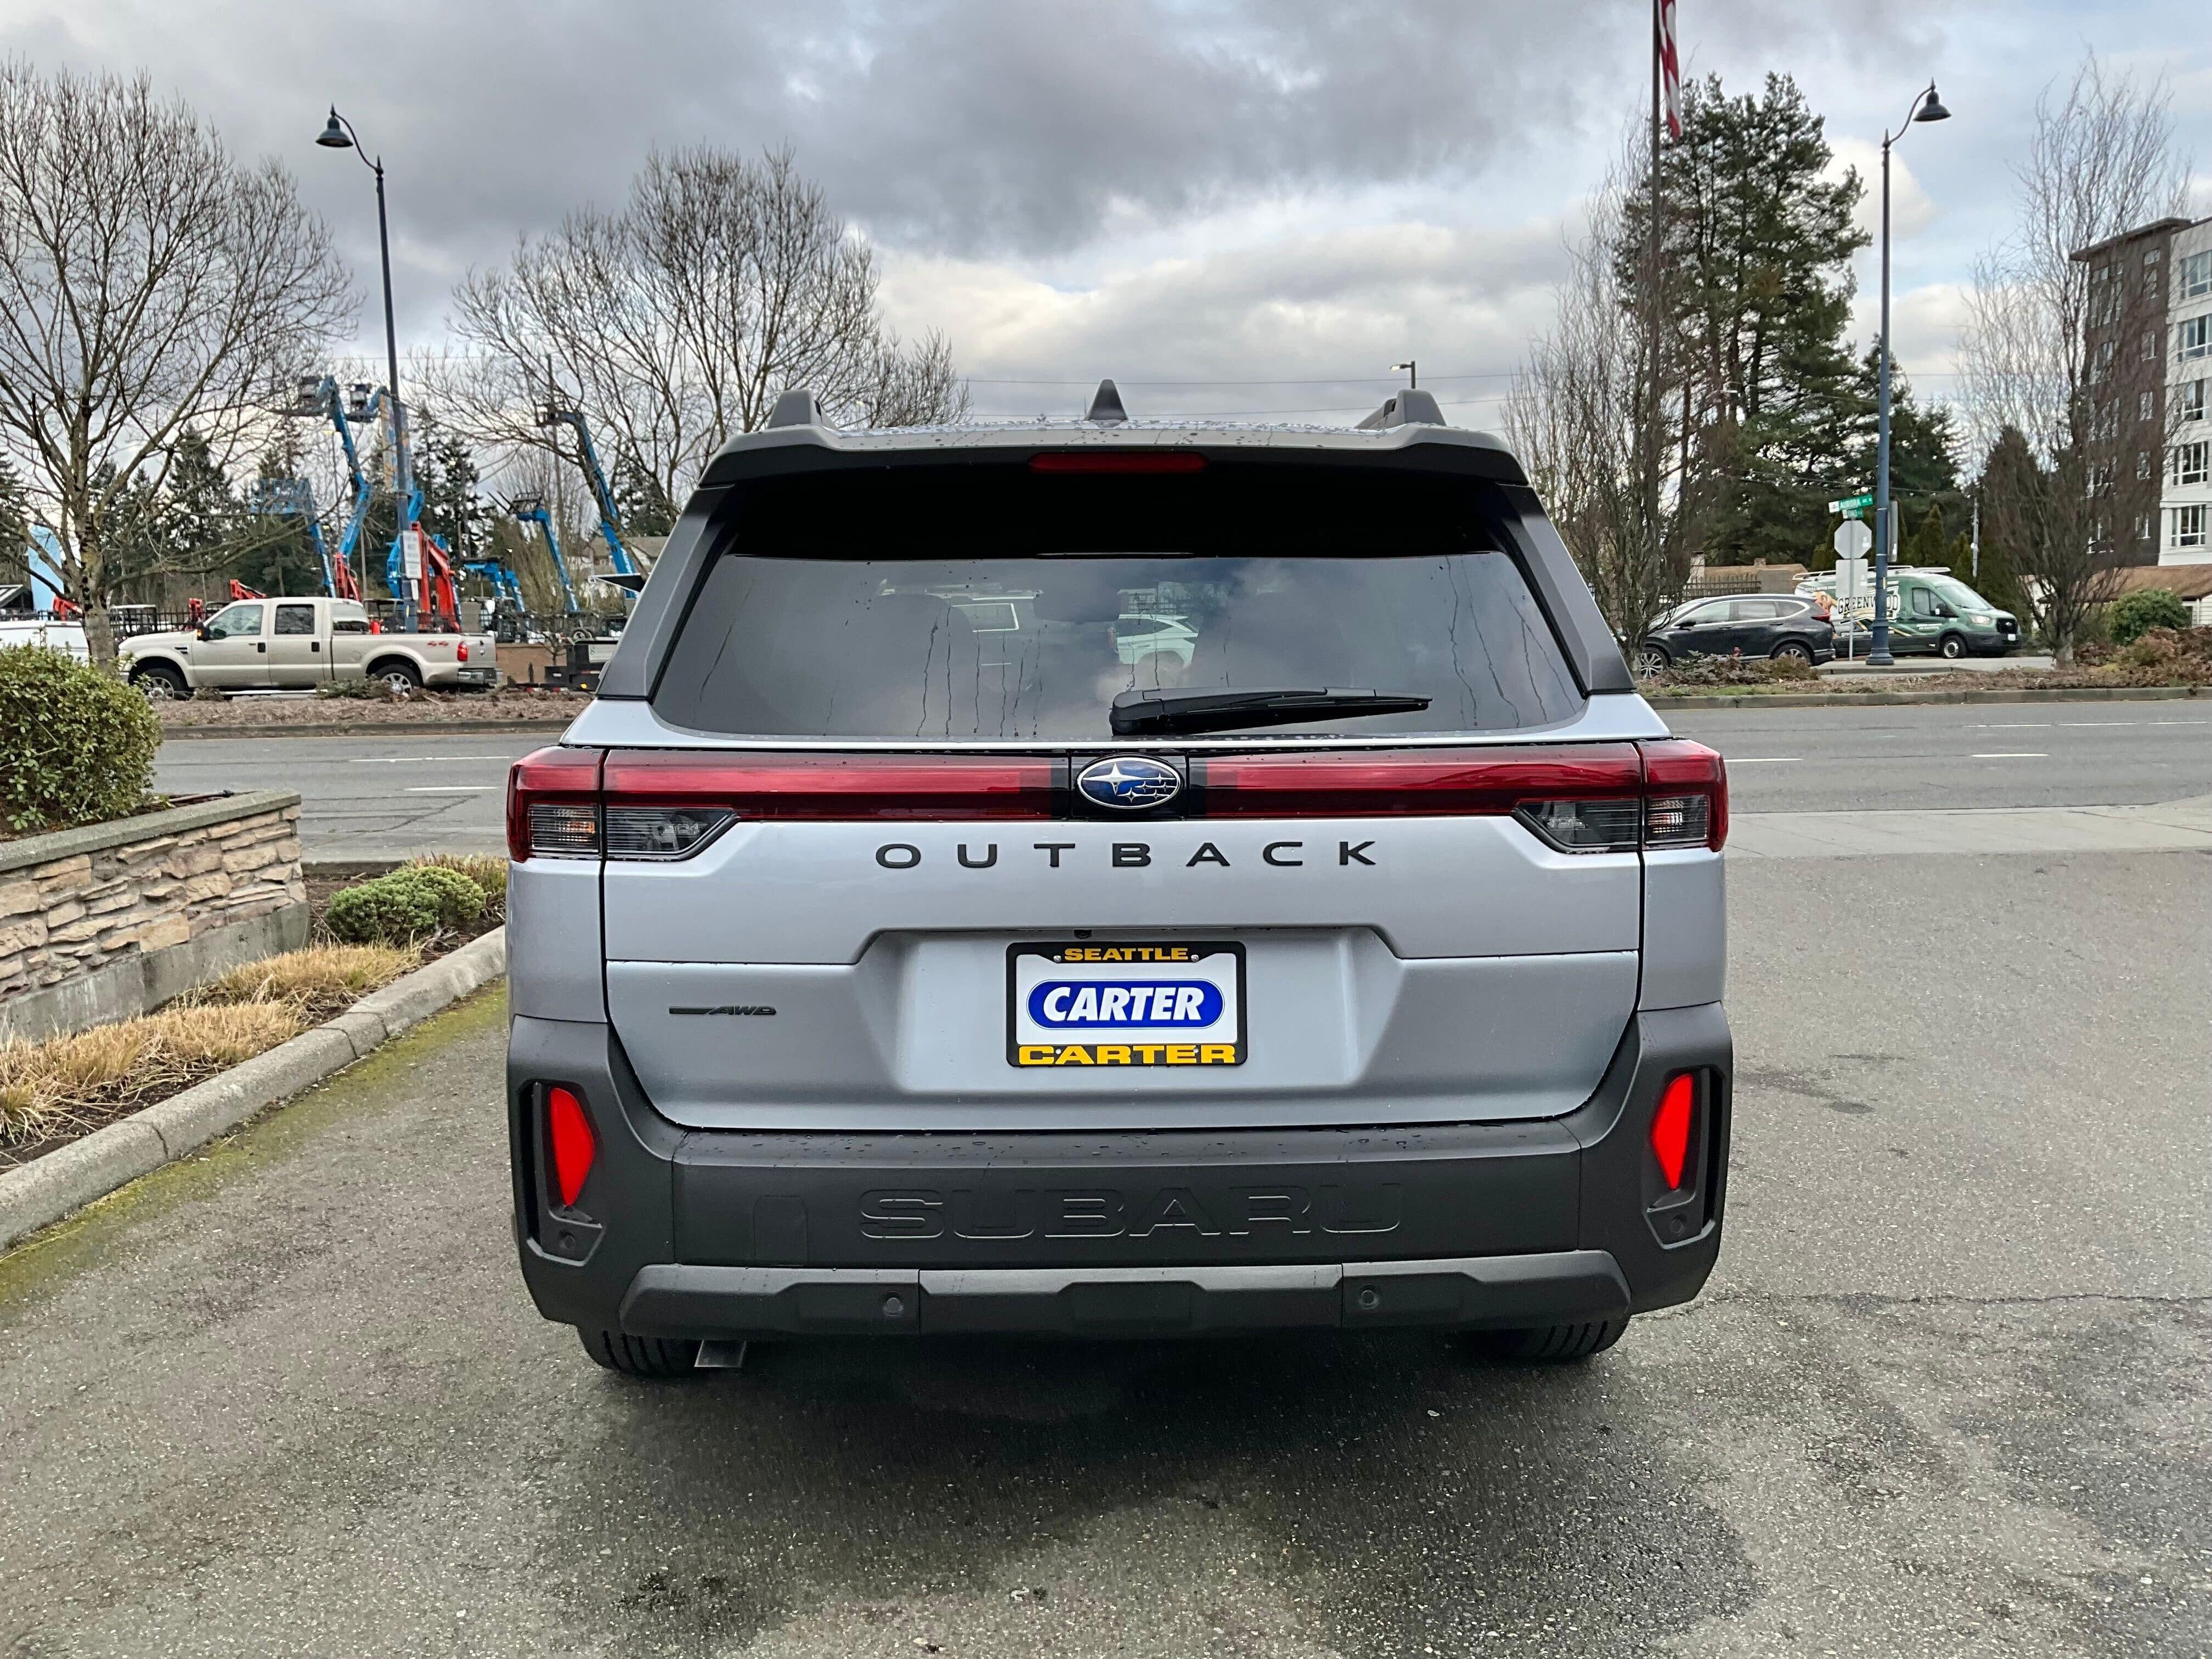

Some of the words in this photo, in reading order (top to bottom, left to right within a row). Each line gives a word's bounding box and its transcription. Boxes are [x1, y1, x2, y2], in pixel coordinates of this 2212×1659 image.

[1838, 595, 1898, 614] GREENWOD
[875, 840, 1376, 868] OUTBACK
[1064, 947, 1188, 961] SEATTLE
[708, 1006, 777, 1015] AWD
[1043, 986, 1204, 1022] CARTER
[1018, 1045, 1236, 1065] CARTER
[859, 1183, 1402, 1239] SUBARU
